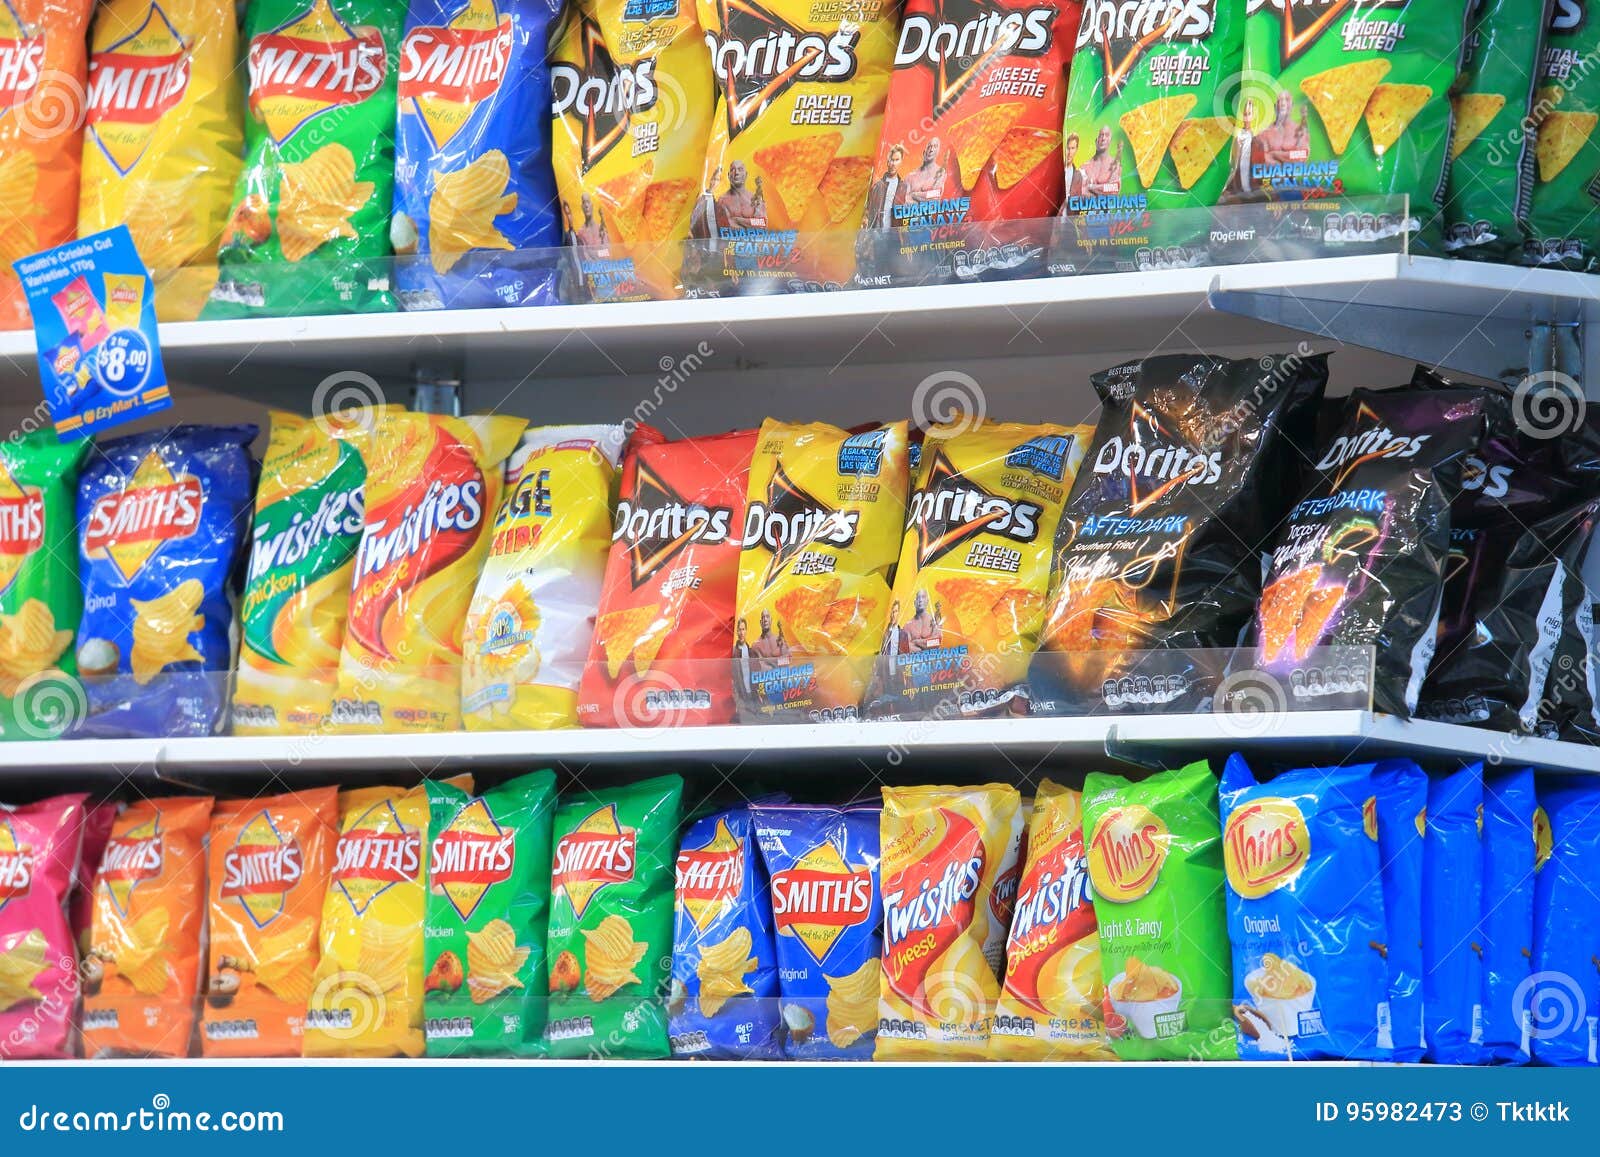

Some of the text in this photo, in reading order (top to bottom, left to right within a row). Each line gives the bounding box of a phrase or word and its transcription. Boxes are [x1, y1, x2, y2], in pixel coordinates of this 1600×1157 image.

[810, 3, 838, 13] PLUS
[893, 9, 1053, 66] Doritos
[1340, 20, 1407, 39] ORIGINAL
[1342, 35, 1398, 52] SALTED
[1149, 54, 1211, 71] ORIGINAL
[988, 67, 1041, 83] CHEESE
[1151, 70, 1203, 87] SALTED
[980, 82, 1047, 99] SUPREME
[795, 95, 853, 110] NACHO
[790, 109, 853, 126] CHEESE
[1251, 160, 1340, 179] GUARDIANS
[893, 196, 972, 220] GUARDIANS
[1068, 193, 1148, 212] GUARDIANS
[909, 212, 967, 232] GALAXY
[1236, 230, 1255, 241] NET
[20, 253, 58, 276] Smith's
[94, 237, 113, 251] Cut
[71, 259, 96, 275] 170g
[110, 336, 118, 347] 2
[1315, 425, 1432, 471] Doritos
[840, 461, 854, 470] LAS
[1031, 460, 1060, 476] VEGAS
[1093, 435, 1223, 486] Doritos
[88, 487, 199, 538] SMITH'S
[612, 501, 731, 541] Doritos
[906, 488, 1038, 538] Doritos
[352, 479, 482, 592] Twisties
[743, 503, 859, 548] Doritos
[970, 541, 1022, 560] NACHO
[1071, 539, 1138, 552] Southern Fried
[965, 553, 1022, 573] CHEESE
[242, 571, 297, 620] Chicken
[750, 662, 815, 684] GUARDIANS
[1092, 811, 1159, 887] Thins
[1228, 804, 1300, 880] Thins
[332, 836, 420, 873] SMITH'S
[431, 834, 513, 874] SMITH'S
[553, 836, 633, 876] SMITH'S
[224, 846, 301, 889] SMITH'S
[772, 875, 870, 914] SMITH'S
[883, 857, 983, 956] Twisties
[1100, 918, 1163, 944] Light & Tangy
[1244, 915, 1281, 938] Original
[892, 932, 937, 981] Cheese
[1007, 927, 1058, 977] Cheese
[1049, 1019, 1068, 1031] 45g
